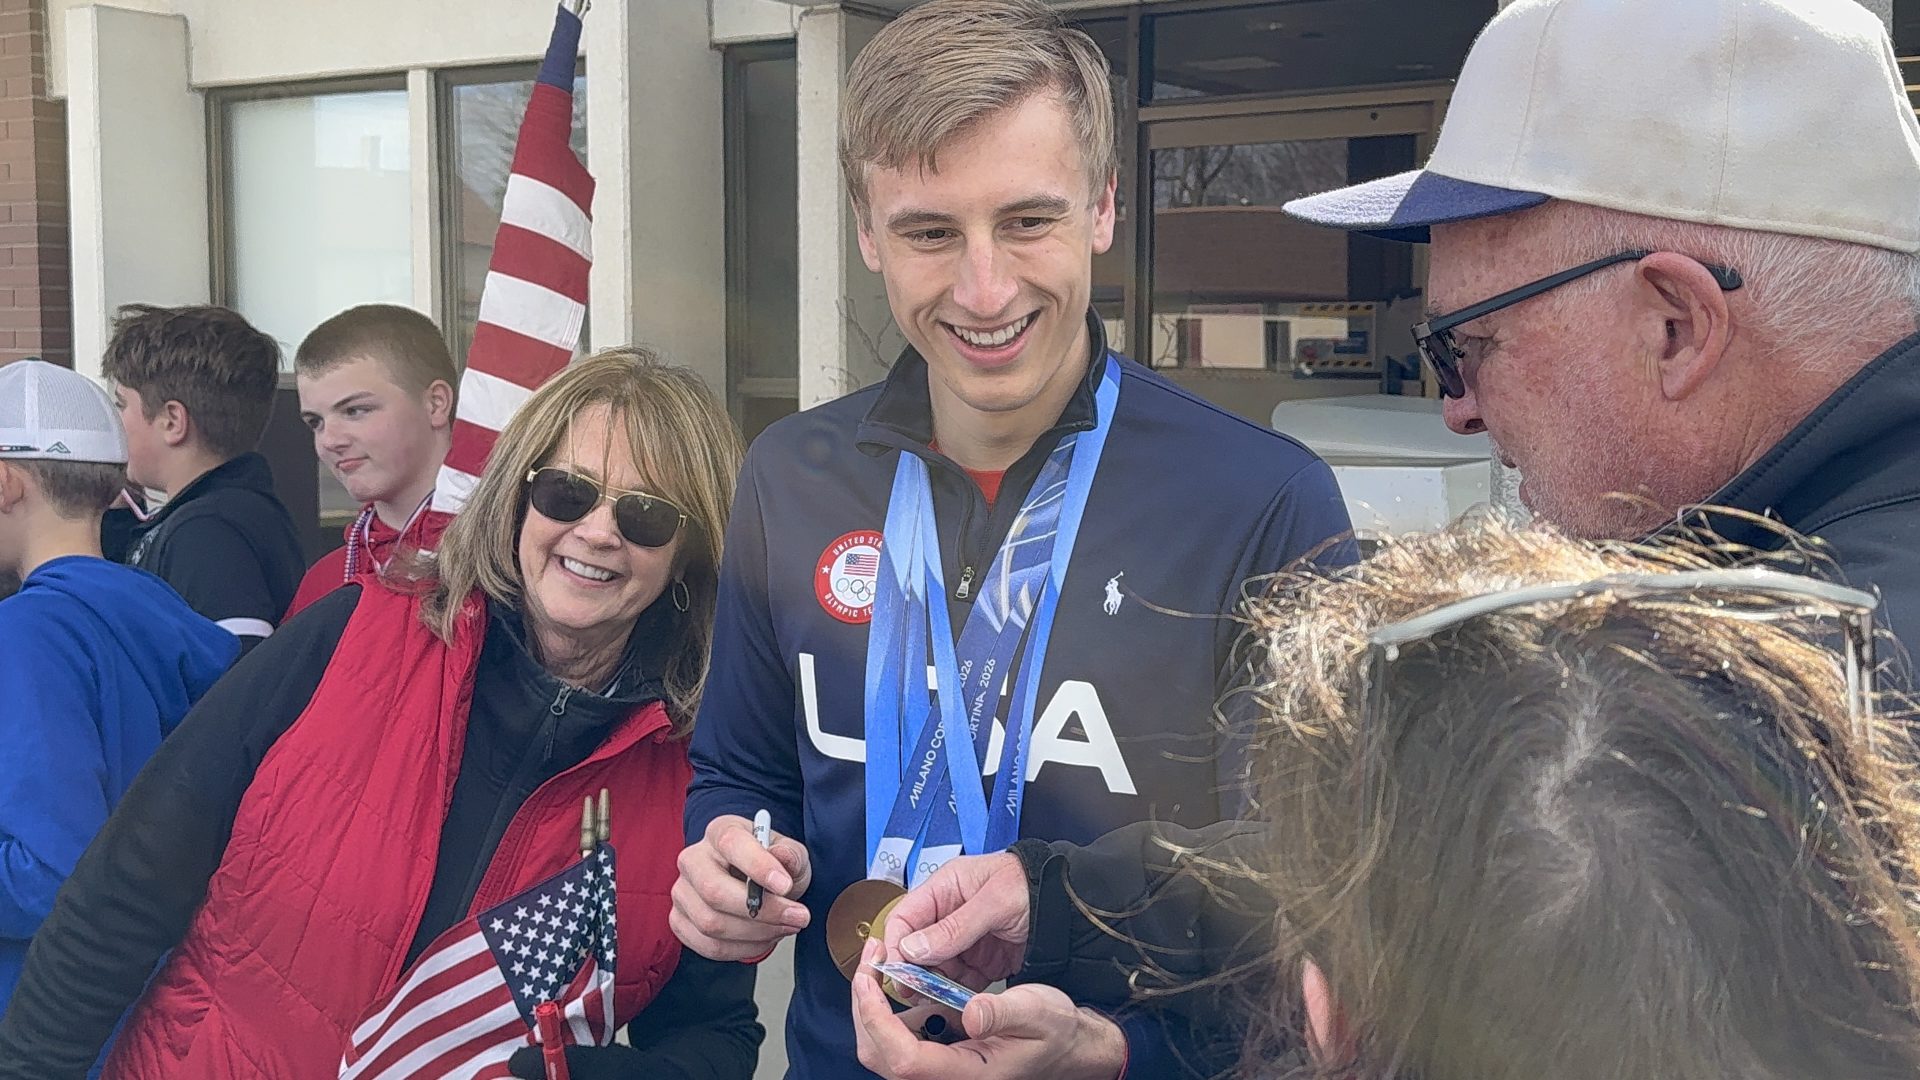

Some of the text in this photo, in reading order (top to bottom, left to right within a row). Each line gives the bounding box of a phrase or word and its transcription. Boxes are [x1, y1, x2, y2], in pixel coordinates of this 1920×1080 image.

[833, 535, 883, 555] UNITED STA
[824, 592, 873, 617] OLYMPIC TE
[980, 658, 996, 688] 2026
[909, 750, 936, 809] MILANO
